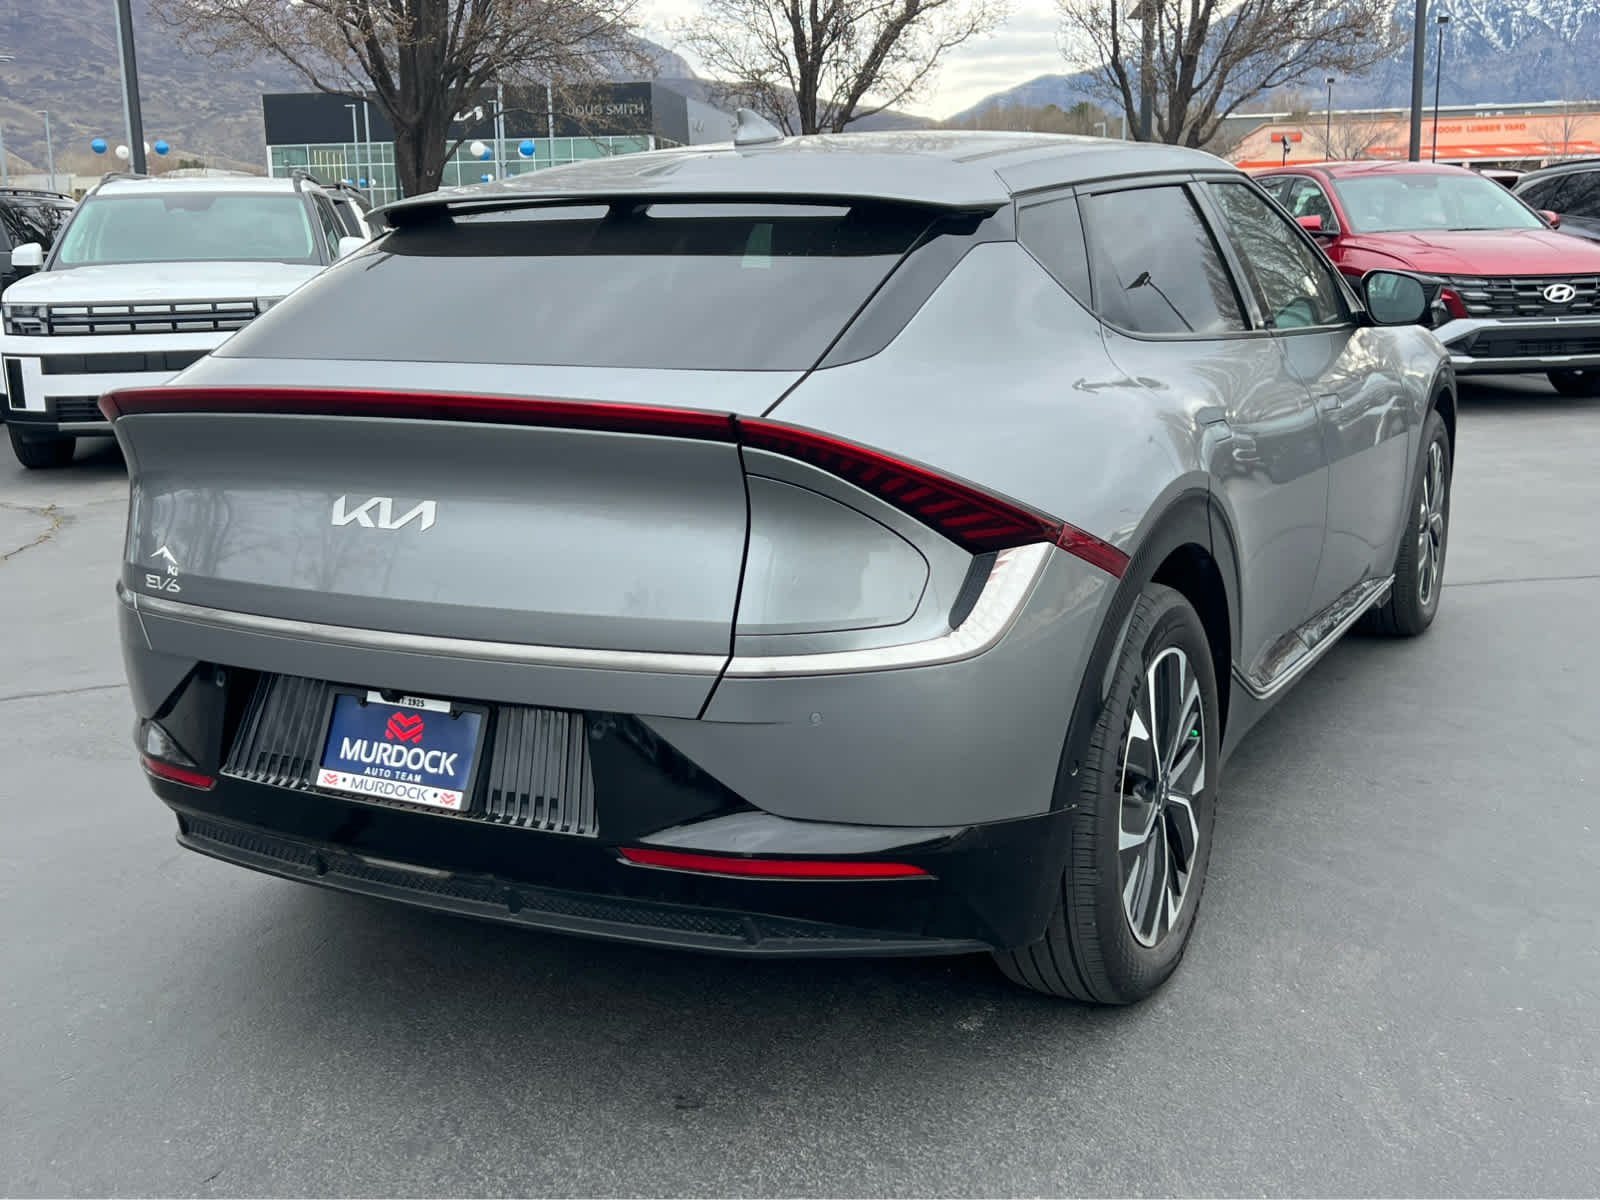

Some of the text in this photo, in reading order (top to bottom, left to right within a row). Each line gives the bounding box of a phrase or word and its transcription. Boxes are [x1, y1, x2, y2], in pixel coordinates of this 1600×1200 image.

[607, 104, 644, 115] SMITH
[331, 495, 437, 532] KIA
[145, 573, 181, 593] EV6
[407, 698, 425, 708] 1925
[1114, 674, 1141, 793] NEXEN
[340, 737, 458, 776] MURDOCK
[364, 766, 422, 783] AUTO TEAM
[350, 776, 429, 801] MURDOCK
